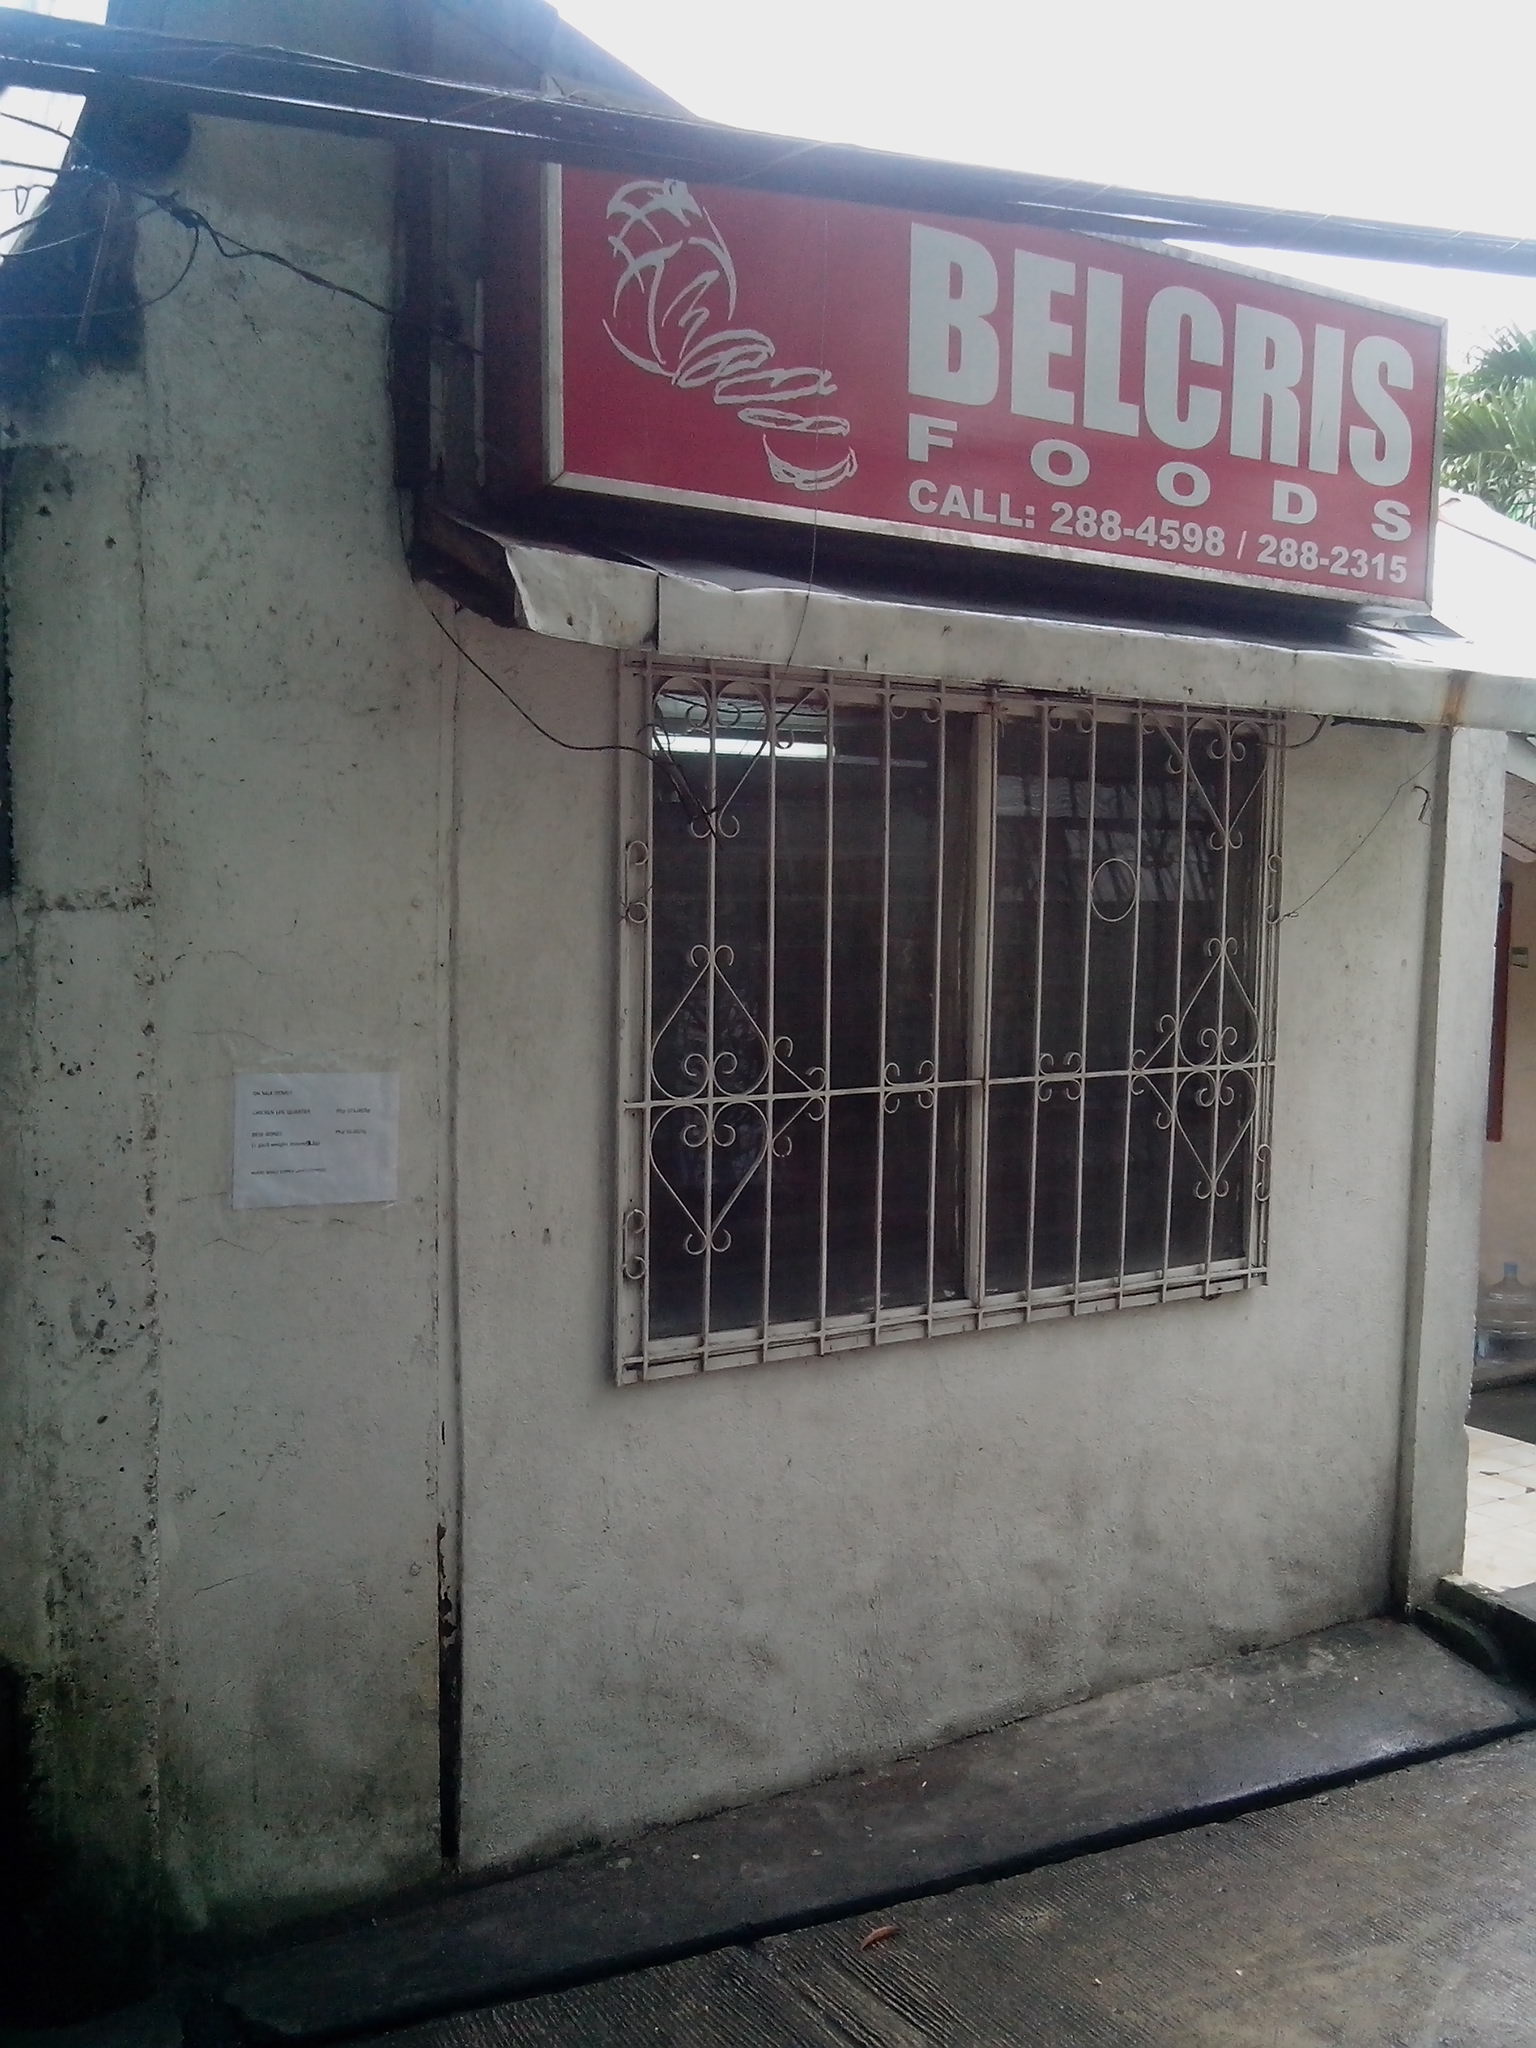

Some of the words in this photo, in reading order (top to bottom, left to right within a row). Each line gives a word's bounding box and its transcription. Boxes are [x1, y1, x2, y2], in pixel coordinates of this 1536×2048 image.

[908, 222, 1414, 487] BELCRIS
[908, 413, 1412, 542] FOODS
[908, 479, 1035, 529] CALL:
[1050, 501, 1226, 557] 288-4598
[1236, 530, 1248, 560] /
[1257, 534, 1408, 583] 288-2315
